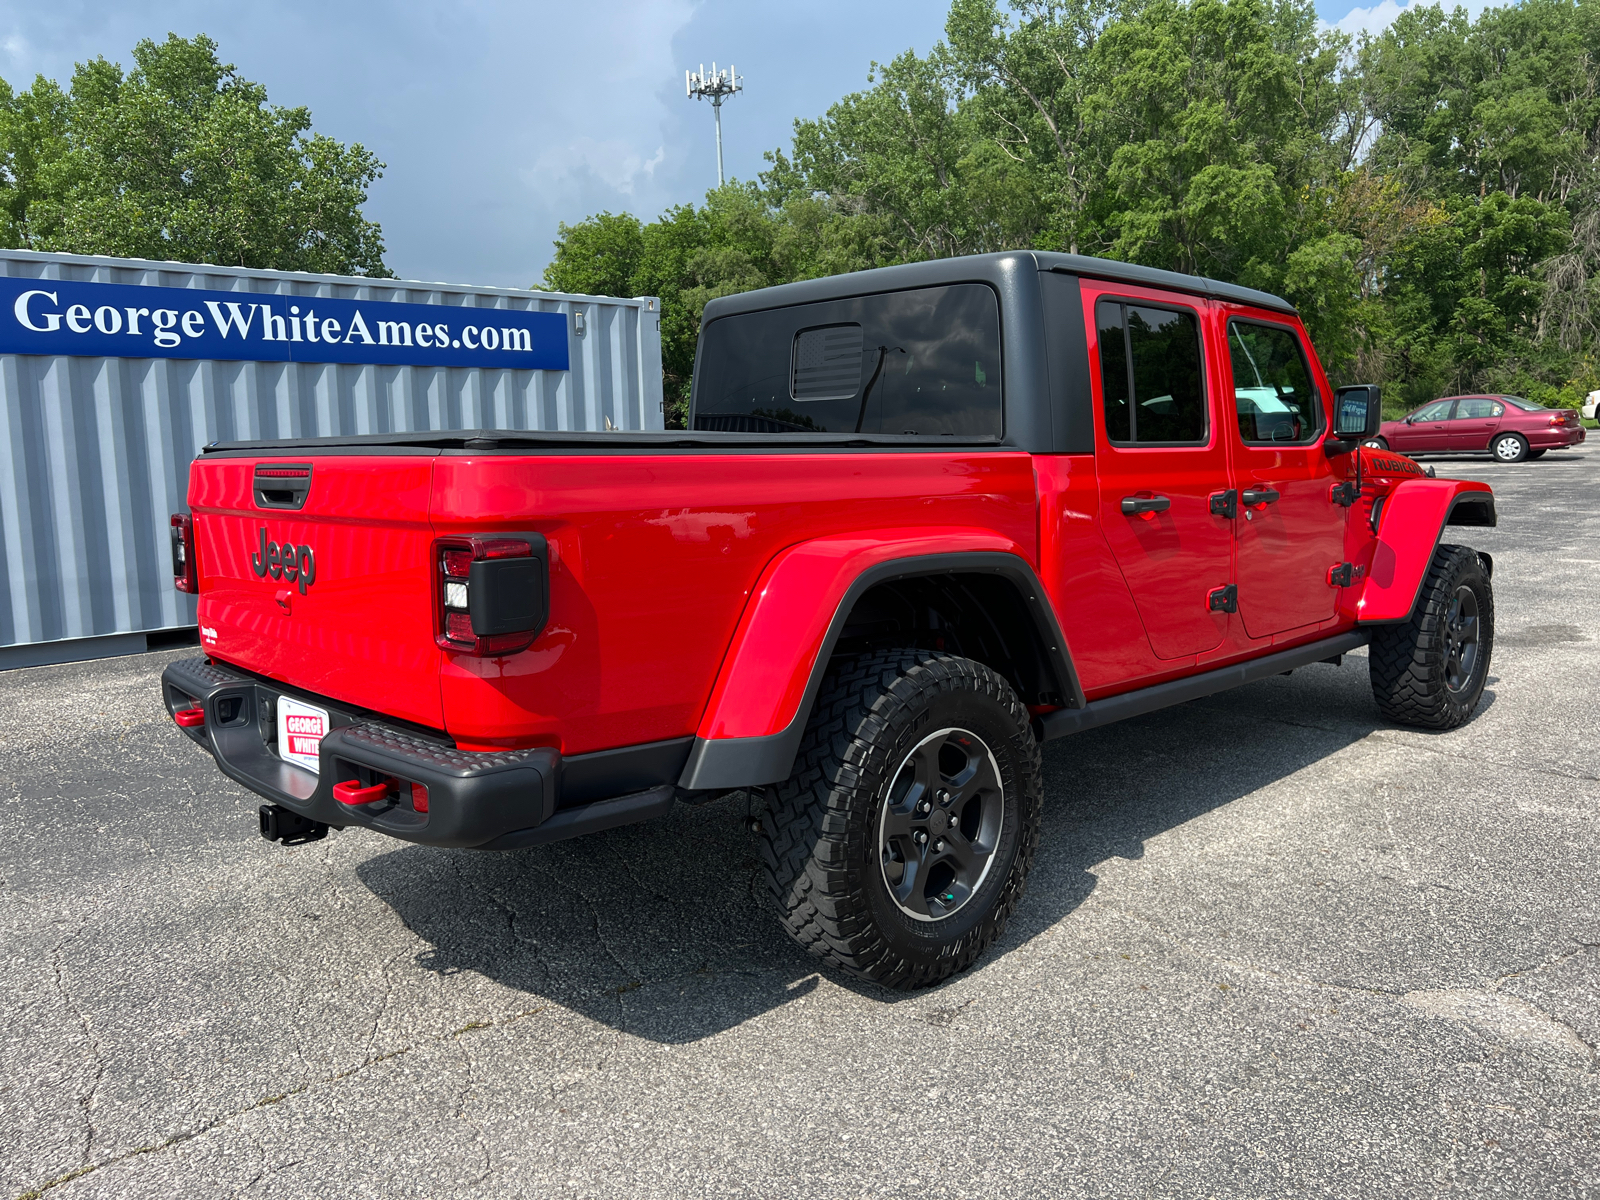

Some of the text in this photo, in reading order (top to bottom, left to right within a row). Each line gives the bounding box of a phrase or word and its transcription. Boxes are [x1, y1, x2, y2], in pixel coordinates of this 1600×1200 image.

[14, 289, 534, 352] GeorgeWhiteAmes.com
[1372, 458, 1423, 475] RUBICON
[252, 527, 317, 596] Jeep
[1351, 563, 1366, 579] eep
[288, 717, 321, 734] GEORGE
[293, 737, 319, 754] WHITE
